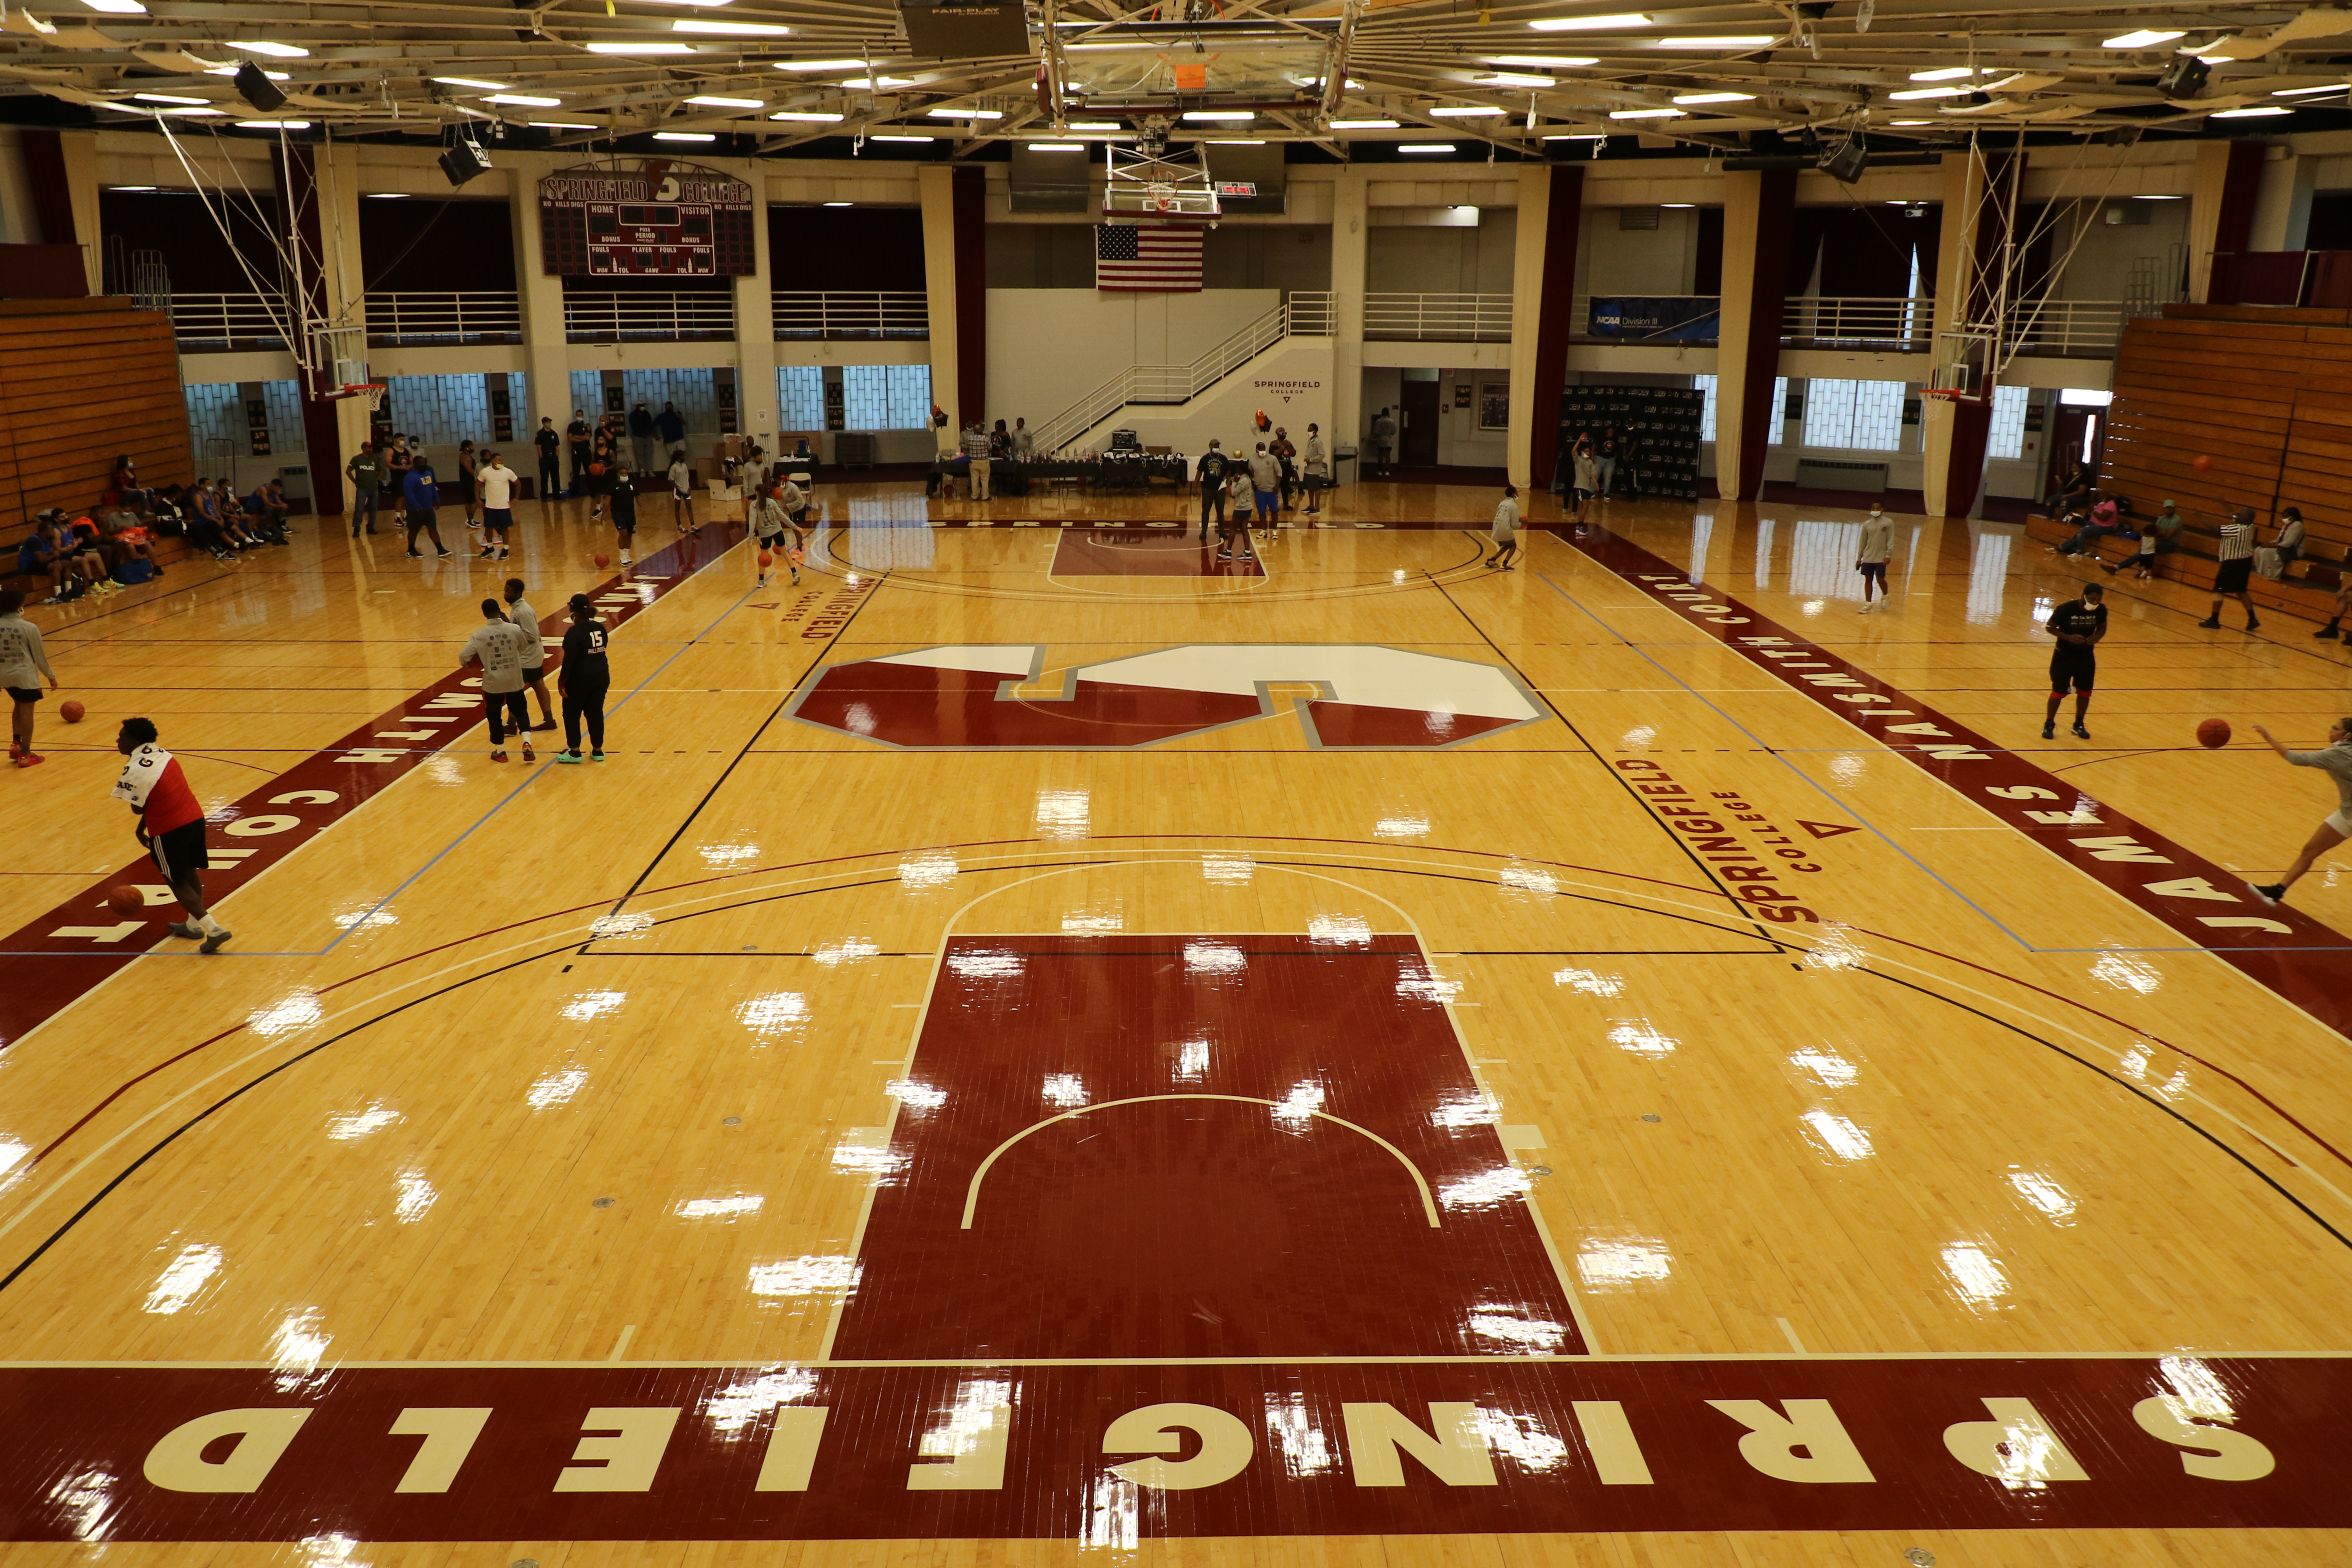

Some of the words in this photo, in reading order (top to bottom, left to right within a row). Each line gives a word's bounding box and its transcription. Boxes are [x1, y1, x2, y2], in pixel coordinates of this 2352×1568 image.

[546, 178, 648, 201] SPRINGFIELD
[682, 182, 746, 203] COLLEGE
[591, 205, 614, 213] HOME
[1596, 316, 1620, 325] NCAA
[781, 591, 824, 622] COLLEGE
[801, 578, 876, 639] SPRINGFIELD
[1639, 575, 1750, 624] COURT
[589, 631, 603, 647] 15
[1737, 637, 1993, 760] NAISMITH
[1615, 760, 1819, 923] SPRINGFIELD
[1711, 792, 1822, 873] COLLEGE
[1985, 785, 2293, 934] JAMES
[143, 1395, 2275, 1493] SPRINGFIELD
